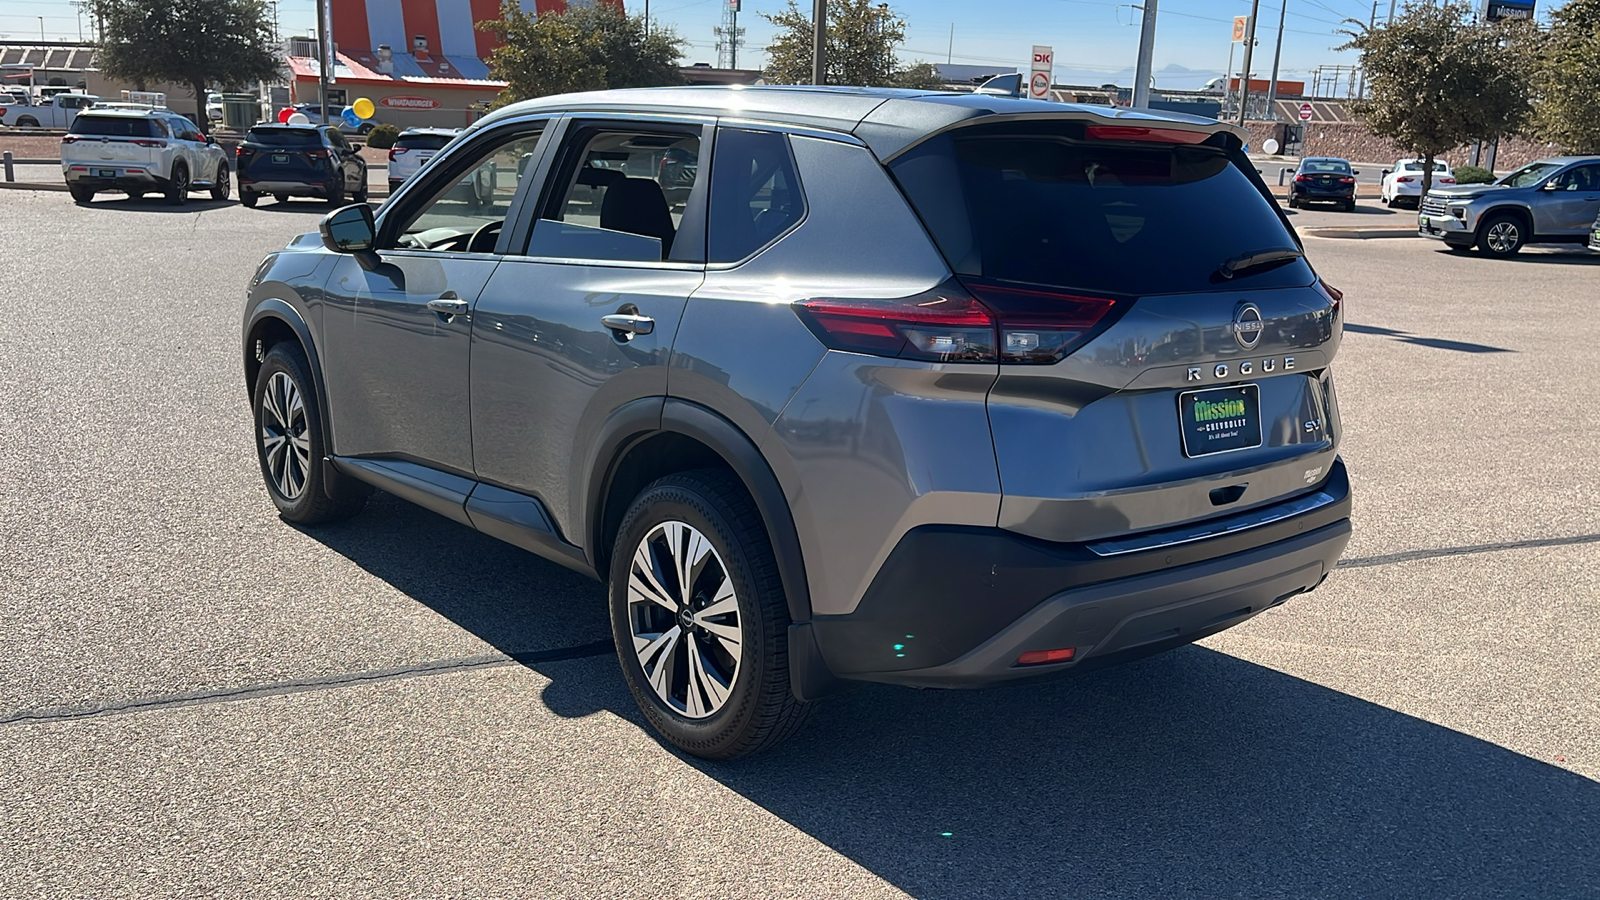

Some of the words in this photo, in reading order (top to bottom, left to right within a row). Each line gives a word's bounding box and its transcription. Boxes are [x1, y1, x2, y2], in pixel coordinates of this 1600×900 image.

[1034, 53, 1050, 63] DK
[387, 98, 433, 107] WHATABURGER
[1187, 357, 1295, 380] ROGUE
[1194, 398, 1245, 421] Mission
[1205, 418, 1246, 432] CHEVROLET
[1304, 418, 1320, 433] SV
